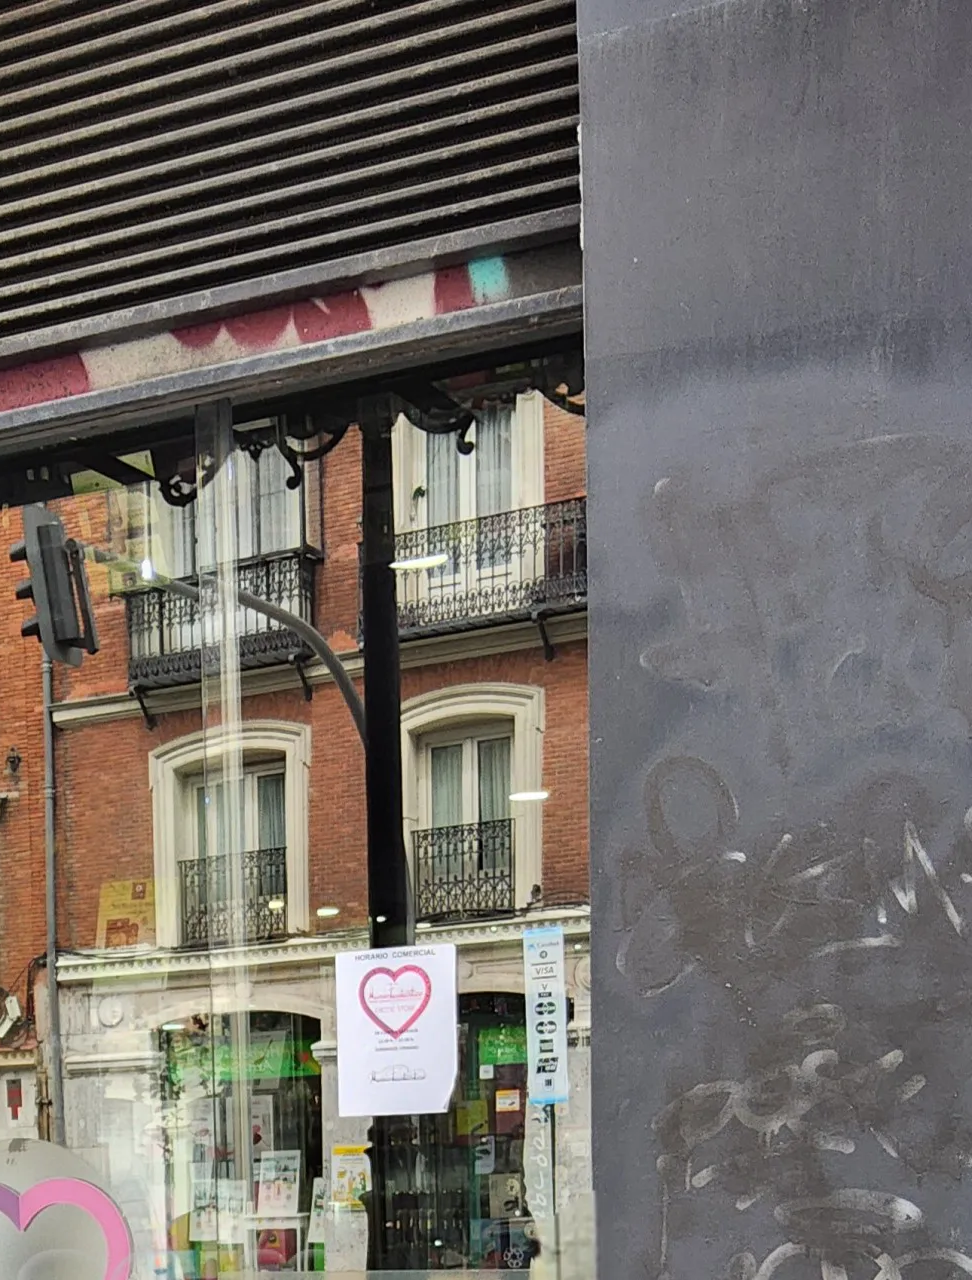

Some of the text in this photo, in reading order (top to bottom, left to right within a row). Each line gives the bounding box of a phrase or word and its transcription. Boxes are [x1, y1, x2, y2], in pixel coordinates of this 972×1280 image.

[354, 948, 436, 961] HORARIO COMERCIAL
[535, 966, 554, 975] VISA
